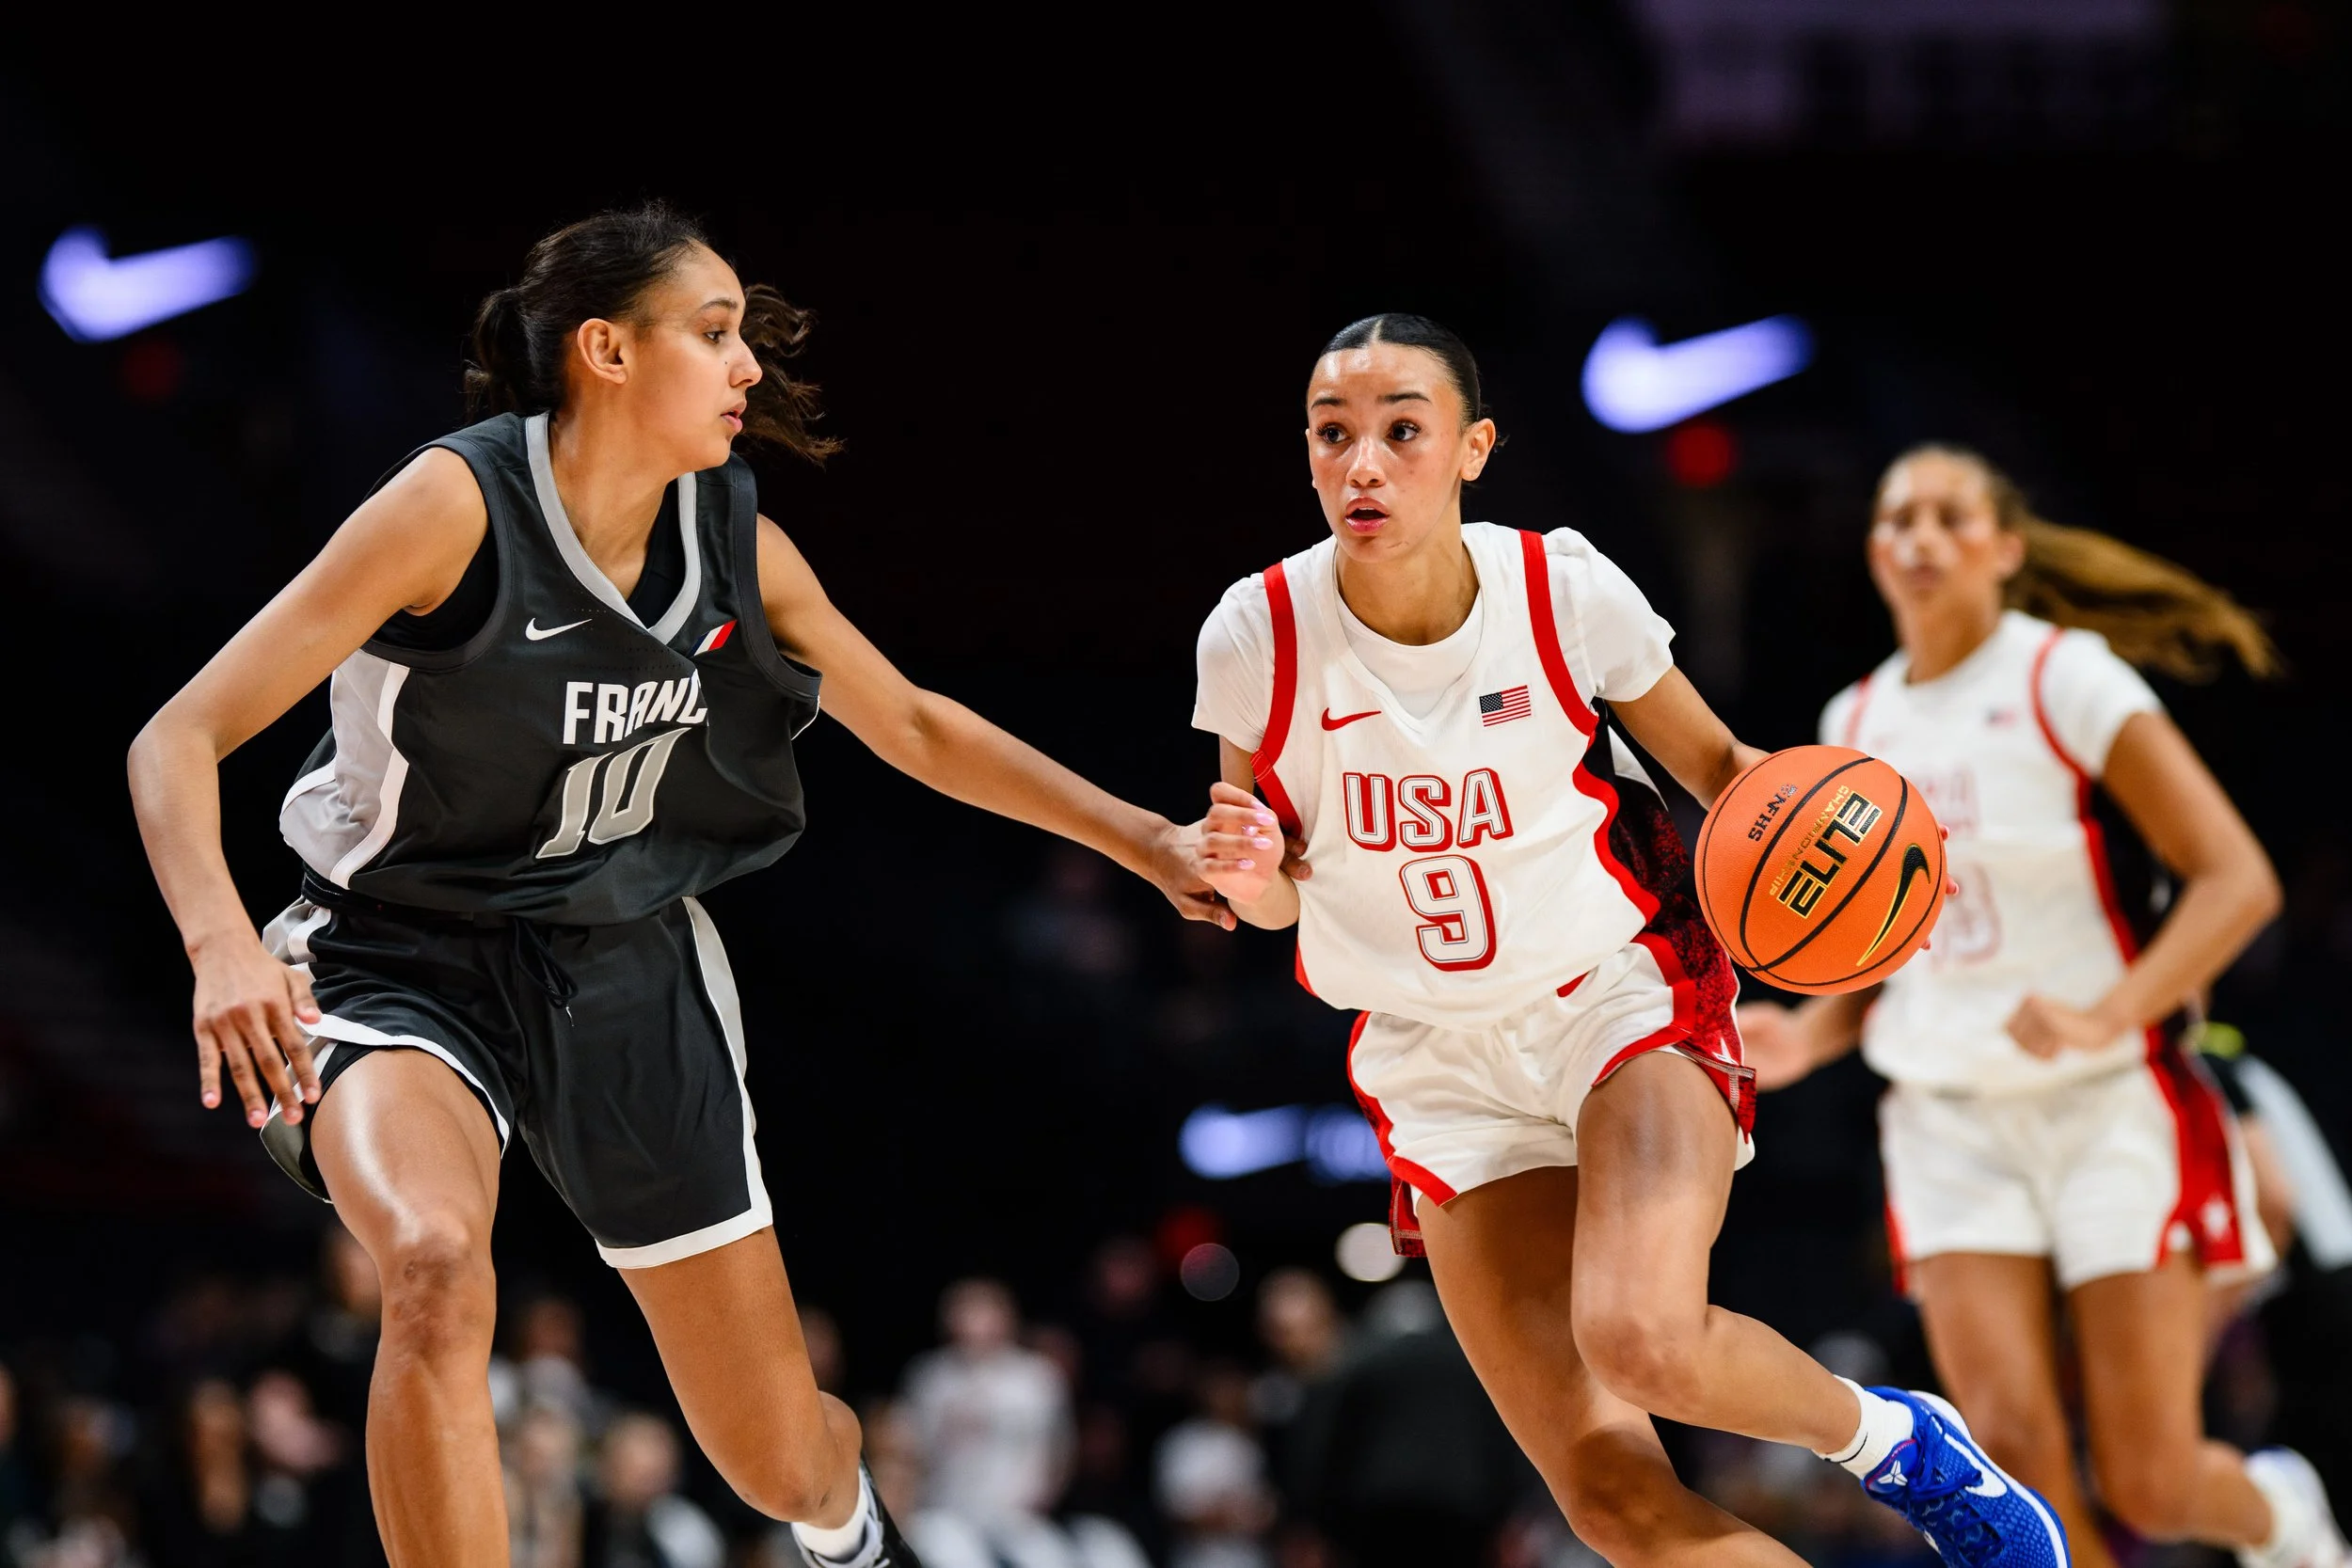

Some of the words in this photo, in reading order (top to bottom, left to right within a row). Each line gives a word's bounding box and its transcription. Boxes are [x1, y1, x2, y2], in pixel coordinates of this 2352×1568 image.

[563, 669, 709, 745] FRANC
[535, 727, 692, 860] 10
[1343, 767, 1514, 852] USA
[1747, 793, 1787, 842] NFHS
[1775, 790, 1883, 920] ELITE
[1399, 854, 1497, 973] 9
